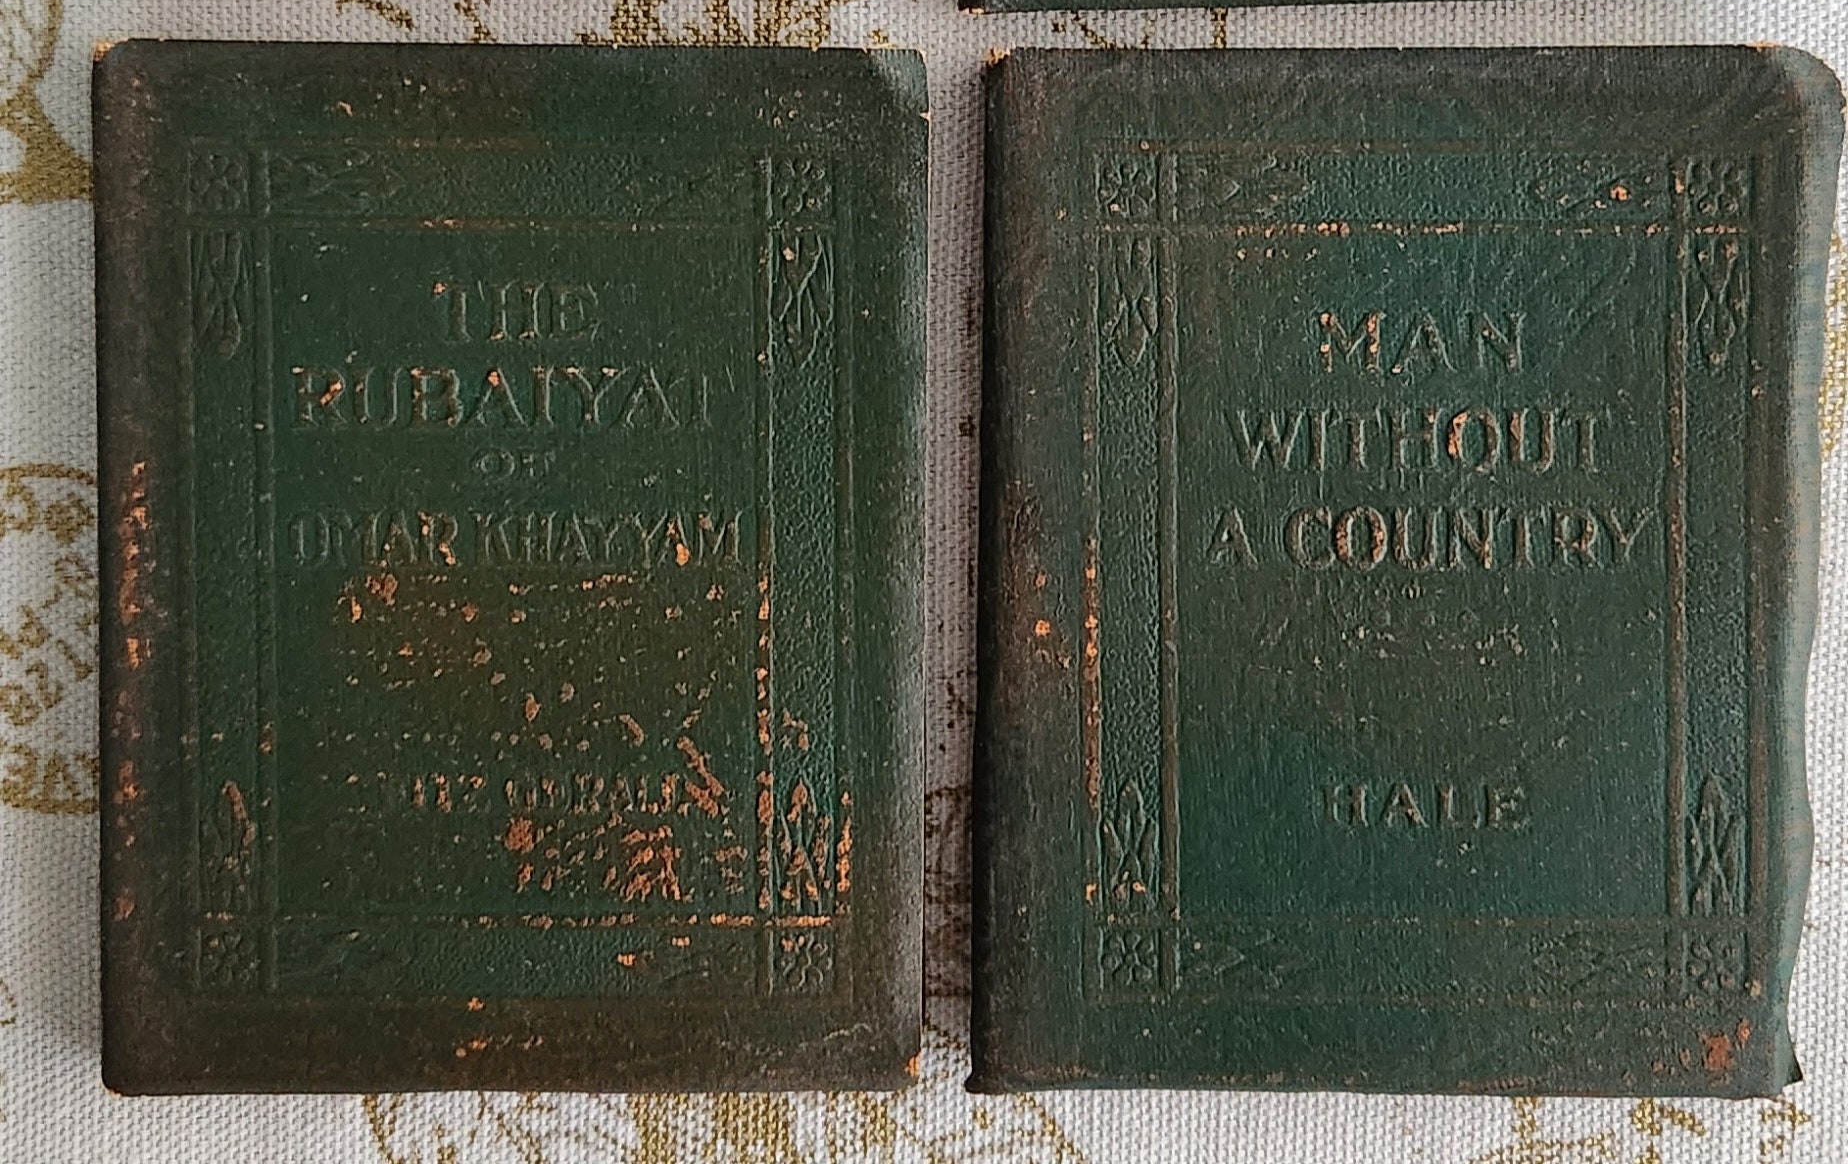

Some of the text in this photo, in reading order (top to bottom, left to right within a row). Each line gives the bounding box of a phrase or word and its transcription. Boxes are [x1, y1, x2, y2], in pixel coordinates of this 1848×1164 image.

[431, 279, 600, 343] THE
[1314, 310, 1528, 376] MAN
[292, 365, 738, 430] RUBAIYAT
[472, 446, 558, 482] OF
[1234, 406, 1612, 476] WITHOUT
[291, 506, 744, 570] OMAR KHAYYAM
[1206, 502, 1658, 572] A COUNTRY
[1322, 781, 1534, 832] HALE
